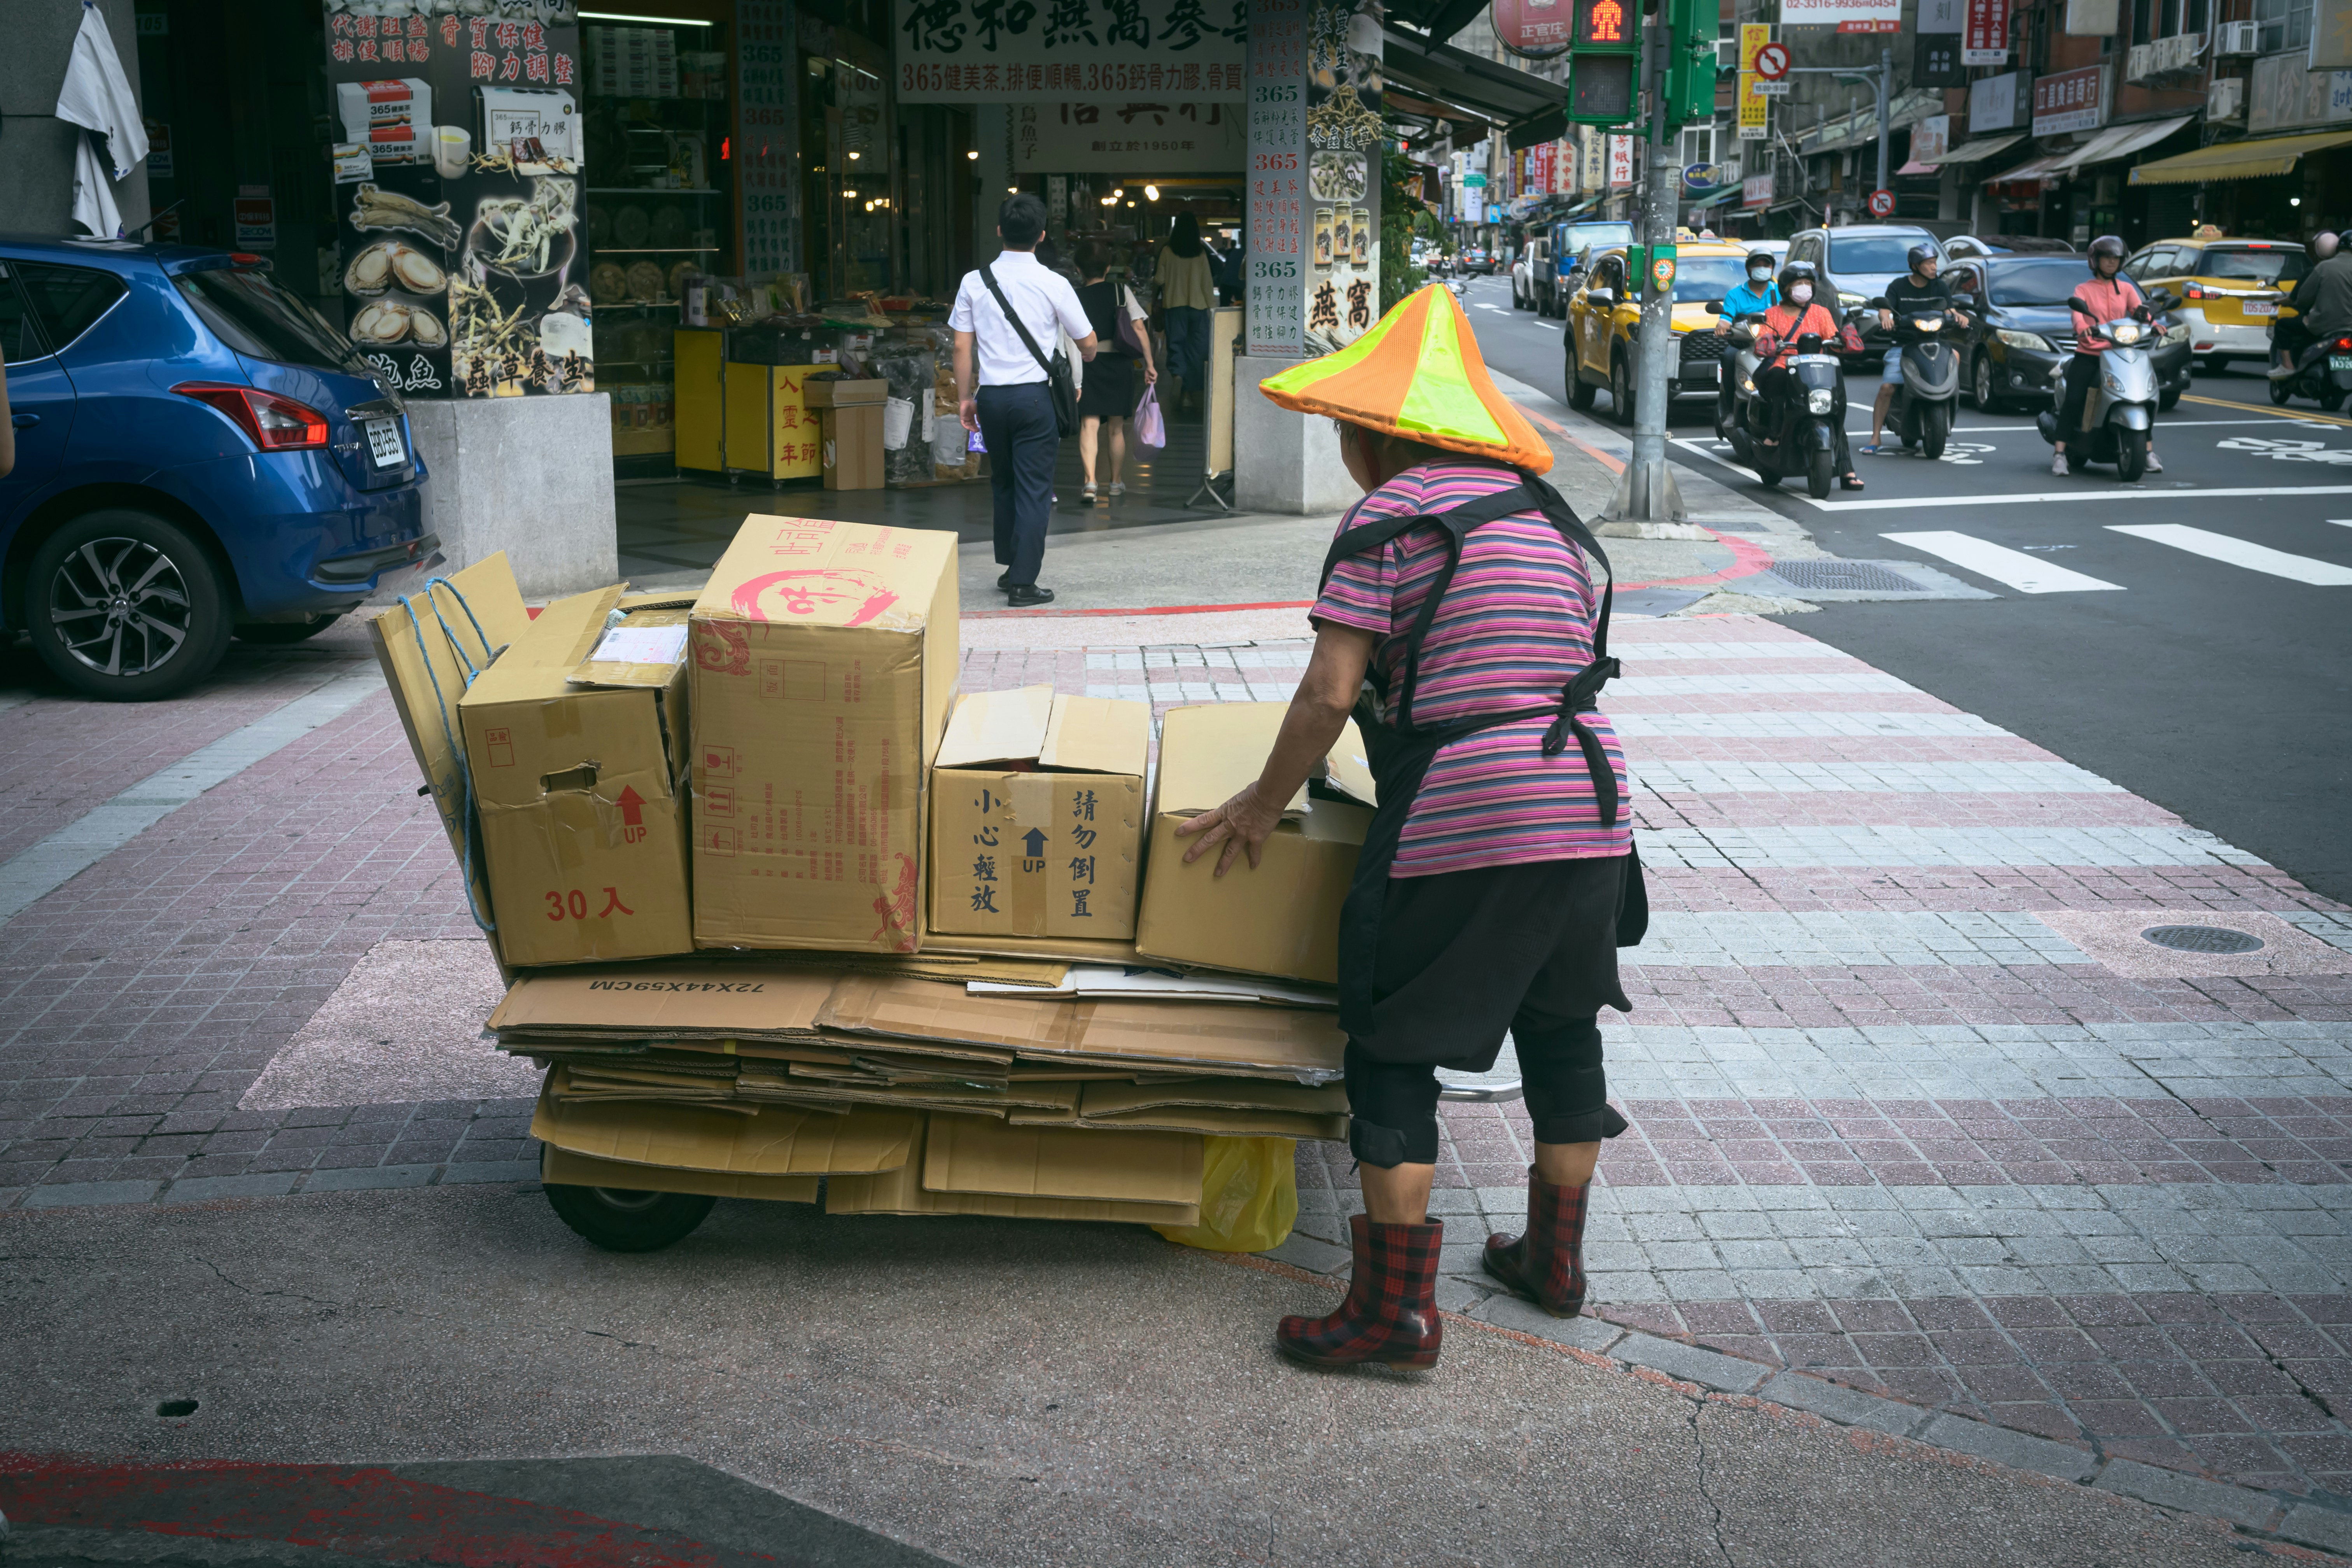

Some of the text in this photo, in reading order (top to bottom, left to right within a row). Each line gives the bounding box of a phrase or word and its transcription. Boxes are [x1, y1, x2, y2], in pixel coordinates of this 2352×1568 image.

[1257, 0, 1300, 13] 365
[332, 14, 428, 38] 代謝旺盛
[440, 14, 547, 51] 骨質保健
[1521, 22, 1565, 38] 正官庄
[332, 39, 430, 62] 排便順暢
[743, 45, 782, 63] 365
[1314, 39, 1349, 70] 養生
[471, 52, 573, 85] 腳力調整
[1255, 85, 1298, 103] 365
[745, 108, 784, 125] 365
[510, 120, 566, 135] 鈣骨力膠
[1091, 140, 1196, 152] 創立於1950年
[1310, 124, 1372, 152] 冬蟲夏草
[1255, 153, 1298, 170] 365
[1254, 179, 1298, 196] 健美茶
[748, 195, 786, 212] 365
[1254, 199, 1300, 215] 排便順暢
[238, 212, 270, 222] 中保科技
[240, 227, 271, 236] SECOM
[1253, 236, 1298, 254] 代謝旺盛
[1255, 261, 1296, 278] 365
[1253, 285, 1298, 301] 鈣骨力膠
[1253, 304, 1298, 321] 骨質保健
[1309, 277, 1373, 331] 燕窩
[1253, 324, 1297, 340] 增強腳力
[466, 349, 583, 391] 蟲草養生
[781, 443, 816, 466] 年節
[769, 518, 837, 555] 吐司盒
[766, 663, 779, 694] 版面
[489, 731, 508, 742] 品檢
[624, 826, 647, 844] UP
[971, 789, 1001, 914] 小心輕放
[1068, 790, 1099, 917] 請勿倒置
[1023, 859, 1046, 873] UP
[589, 980, 765, 993] 72X44X59CM
